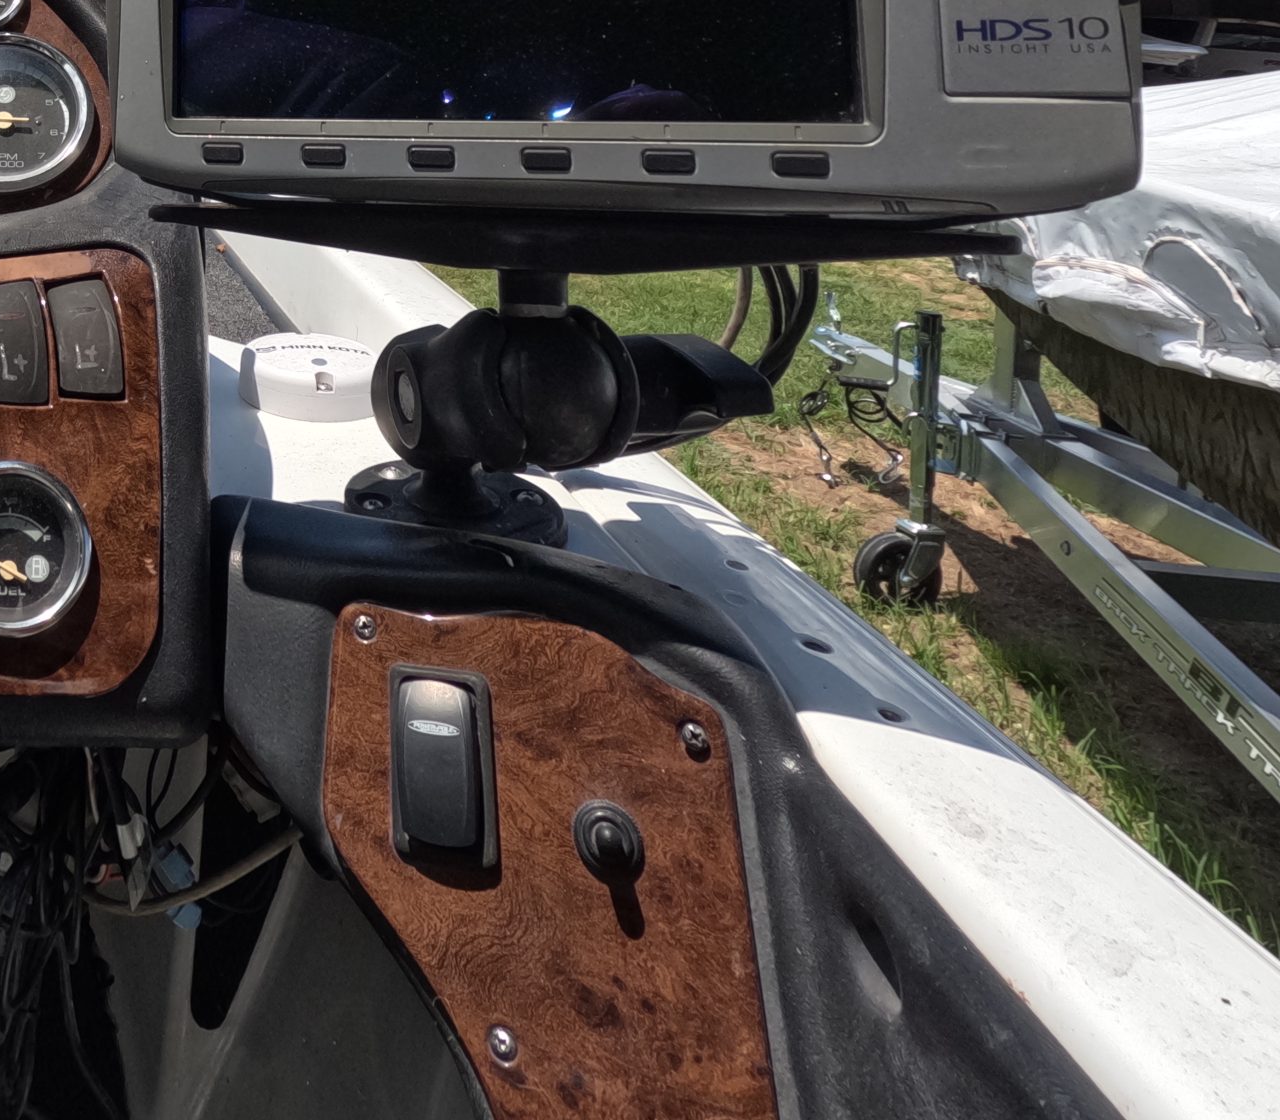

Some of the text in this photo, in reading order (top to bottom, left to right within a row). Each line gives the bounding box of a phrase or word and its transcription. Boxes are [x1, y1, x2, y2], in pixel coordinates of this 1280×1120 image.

[955, 16, 1110, 42] HDS 10
[957, 42, 1113, 55] INSIGHT USA
